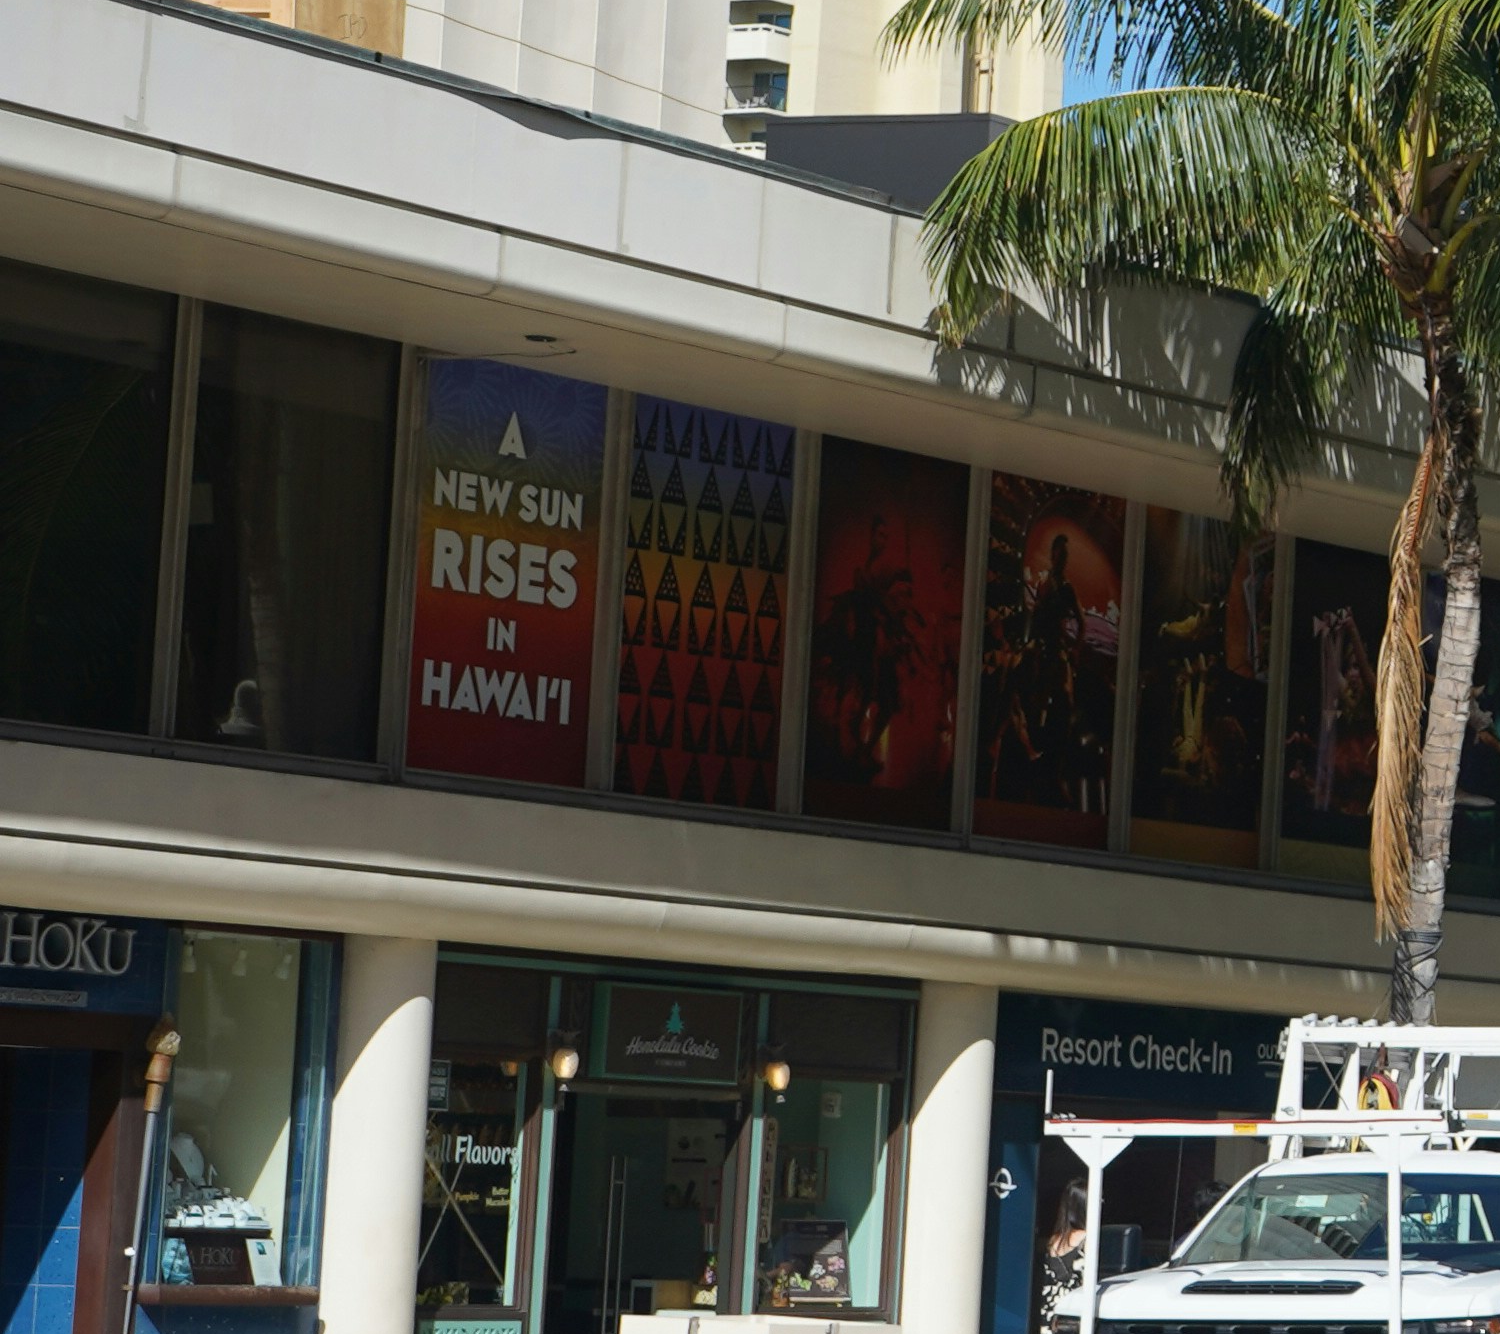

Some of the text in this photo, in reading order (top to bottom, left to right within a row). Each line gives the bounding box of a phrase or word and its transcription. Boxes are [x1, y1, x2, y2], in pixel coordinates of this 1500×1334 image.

[499, 411, 527, 459] A
[433, 467, 583, 531] NEW SUN
[431, 528, 578, 609] RISES
[486, 617, 516, 653] IN
[0, 912, 137, 975] HOKU
[626, 1035, 719, 1060] Honolulu Cookie
[1041, 1027, 1233, 1075] Resort Check-In
[455, 1134, 518, 1166] Flavors
